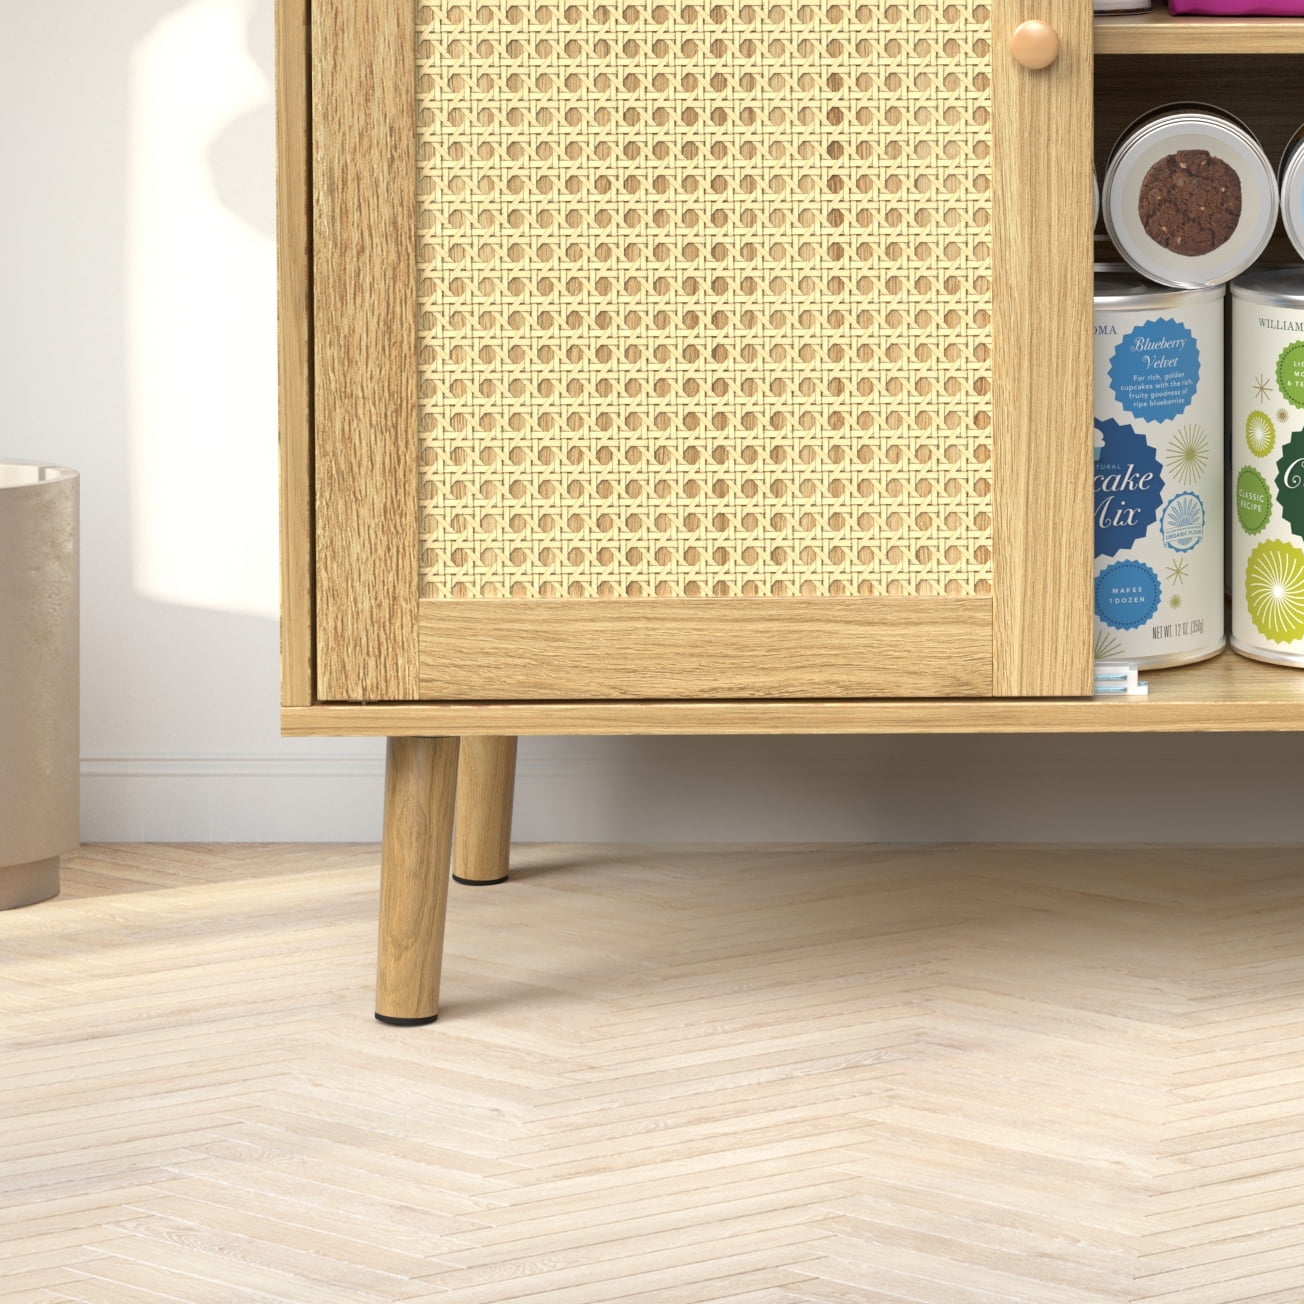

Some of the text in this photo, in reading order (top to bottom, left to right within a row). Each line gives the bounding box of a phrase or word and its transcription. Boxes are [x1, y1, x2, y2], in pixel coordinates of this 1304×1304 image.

[1129, 336, 1187, 352] Blueberry
[1142, 355, 1178, 370] Velvet
[1133, 374, 1144, 382] For
[1164, 372, 1185, 381] golden
[1120, 383, 1153, 392] cupcakes
[1155, 381, 1168, 389] with
[1129, 391, 1148, 399] fruity
[1150, 390, 1180, 399] goodness
[1149, 398, 1185, 407] blueberries
[1239, 489, 1265, 503] CLASSIC
[1240, 501, 1263, 513] RECIPE
[1112, 586, 1143, 594] MAKES
[1152, 626, 1163, 640] NET
